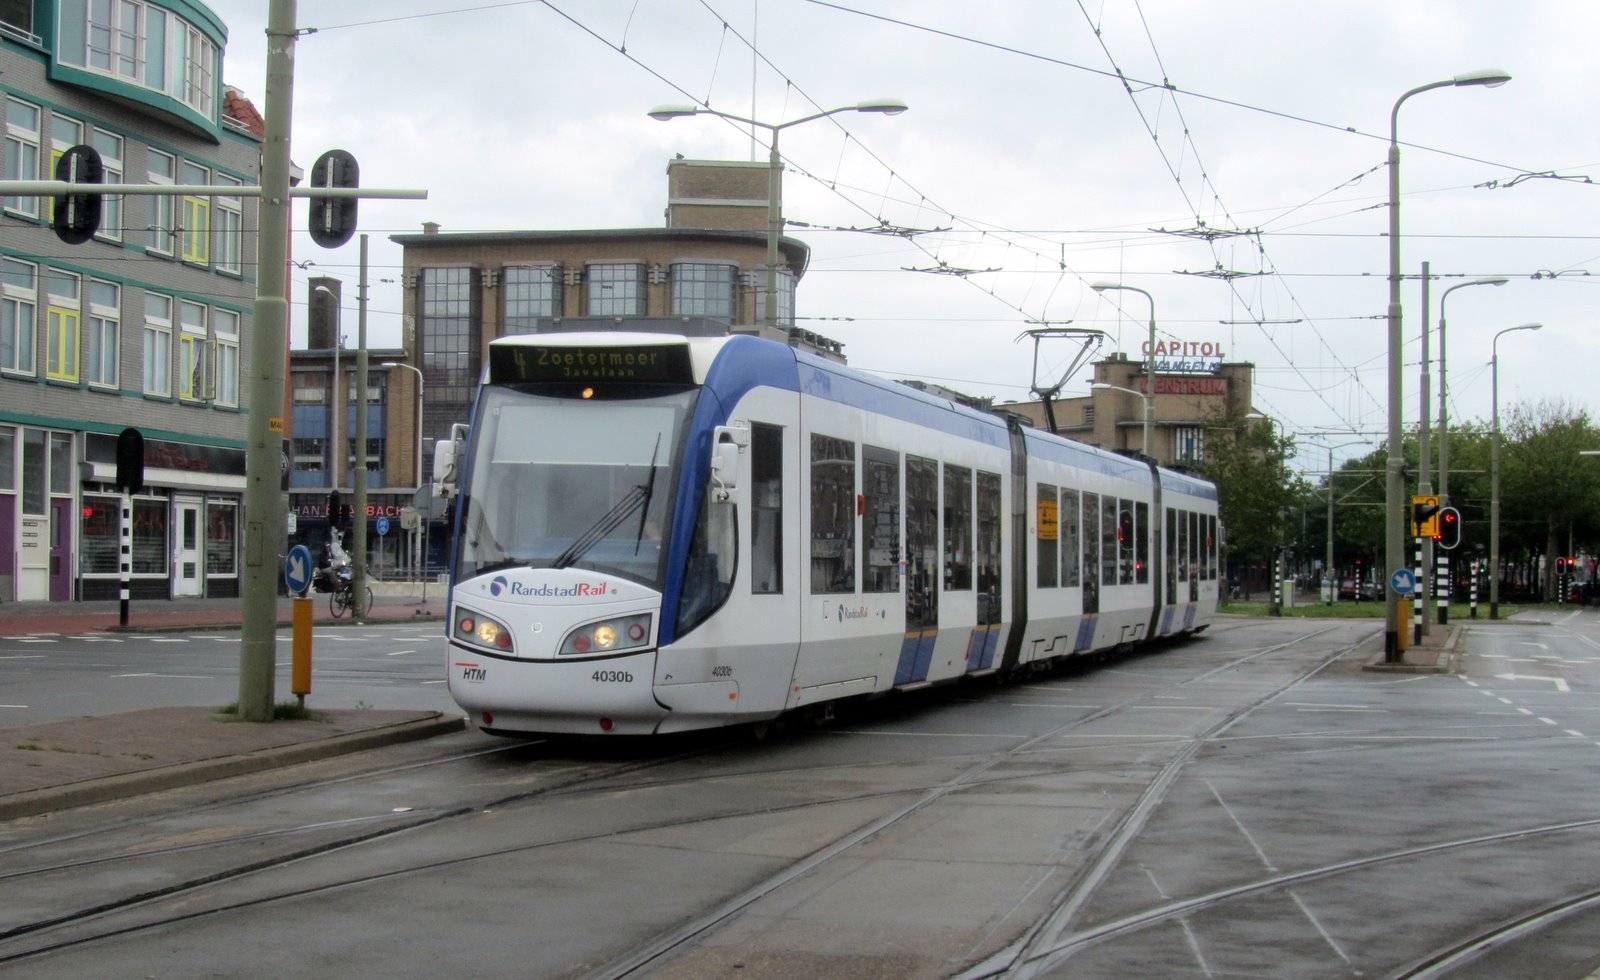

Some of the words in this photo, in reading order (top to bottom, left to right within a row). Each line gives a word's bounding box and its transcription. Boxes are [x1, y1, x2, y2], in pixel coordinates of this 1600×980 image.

[1142, 340, 1225, 357] CAPITOL
[537, 348, 657, 366] Zoetermeer
[563, 367, 634, 377] Javalaan
[1141, 377, 1227, 394] CENTRUM
[511, 581, 607, 597] RandstadRail
[463, 668, 487, 681] HTM
[592, 671, 633, 682] 4030b
[711, 665, 733, 677] 4030b
